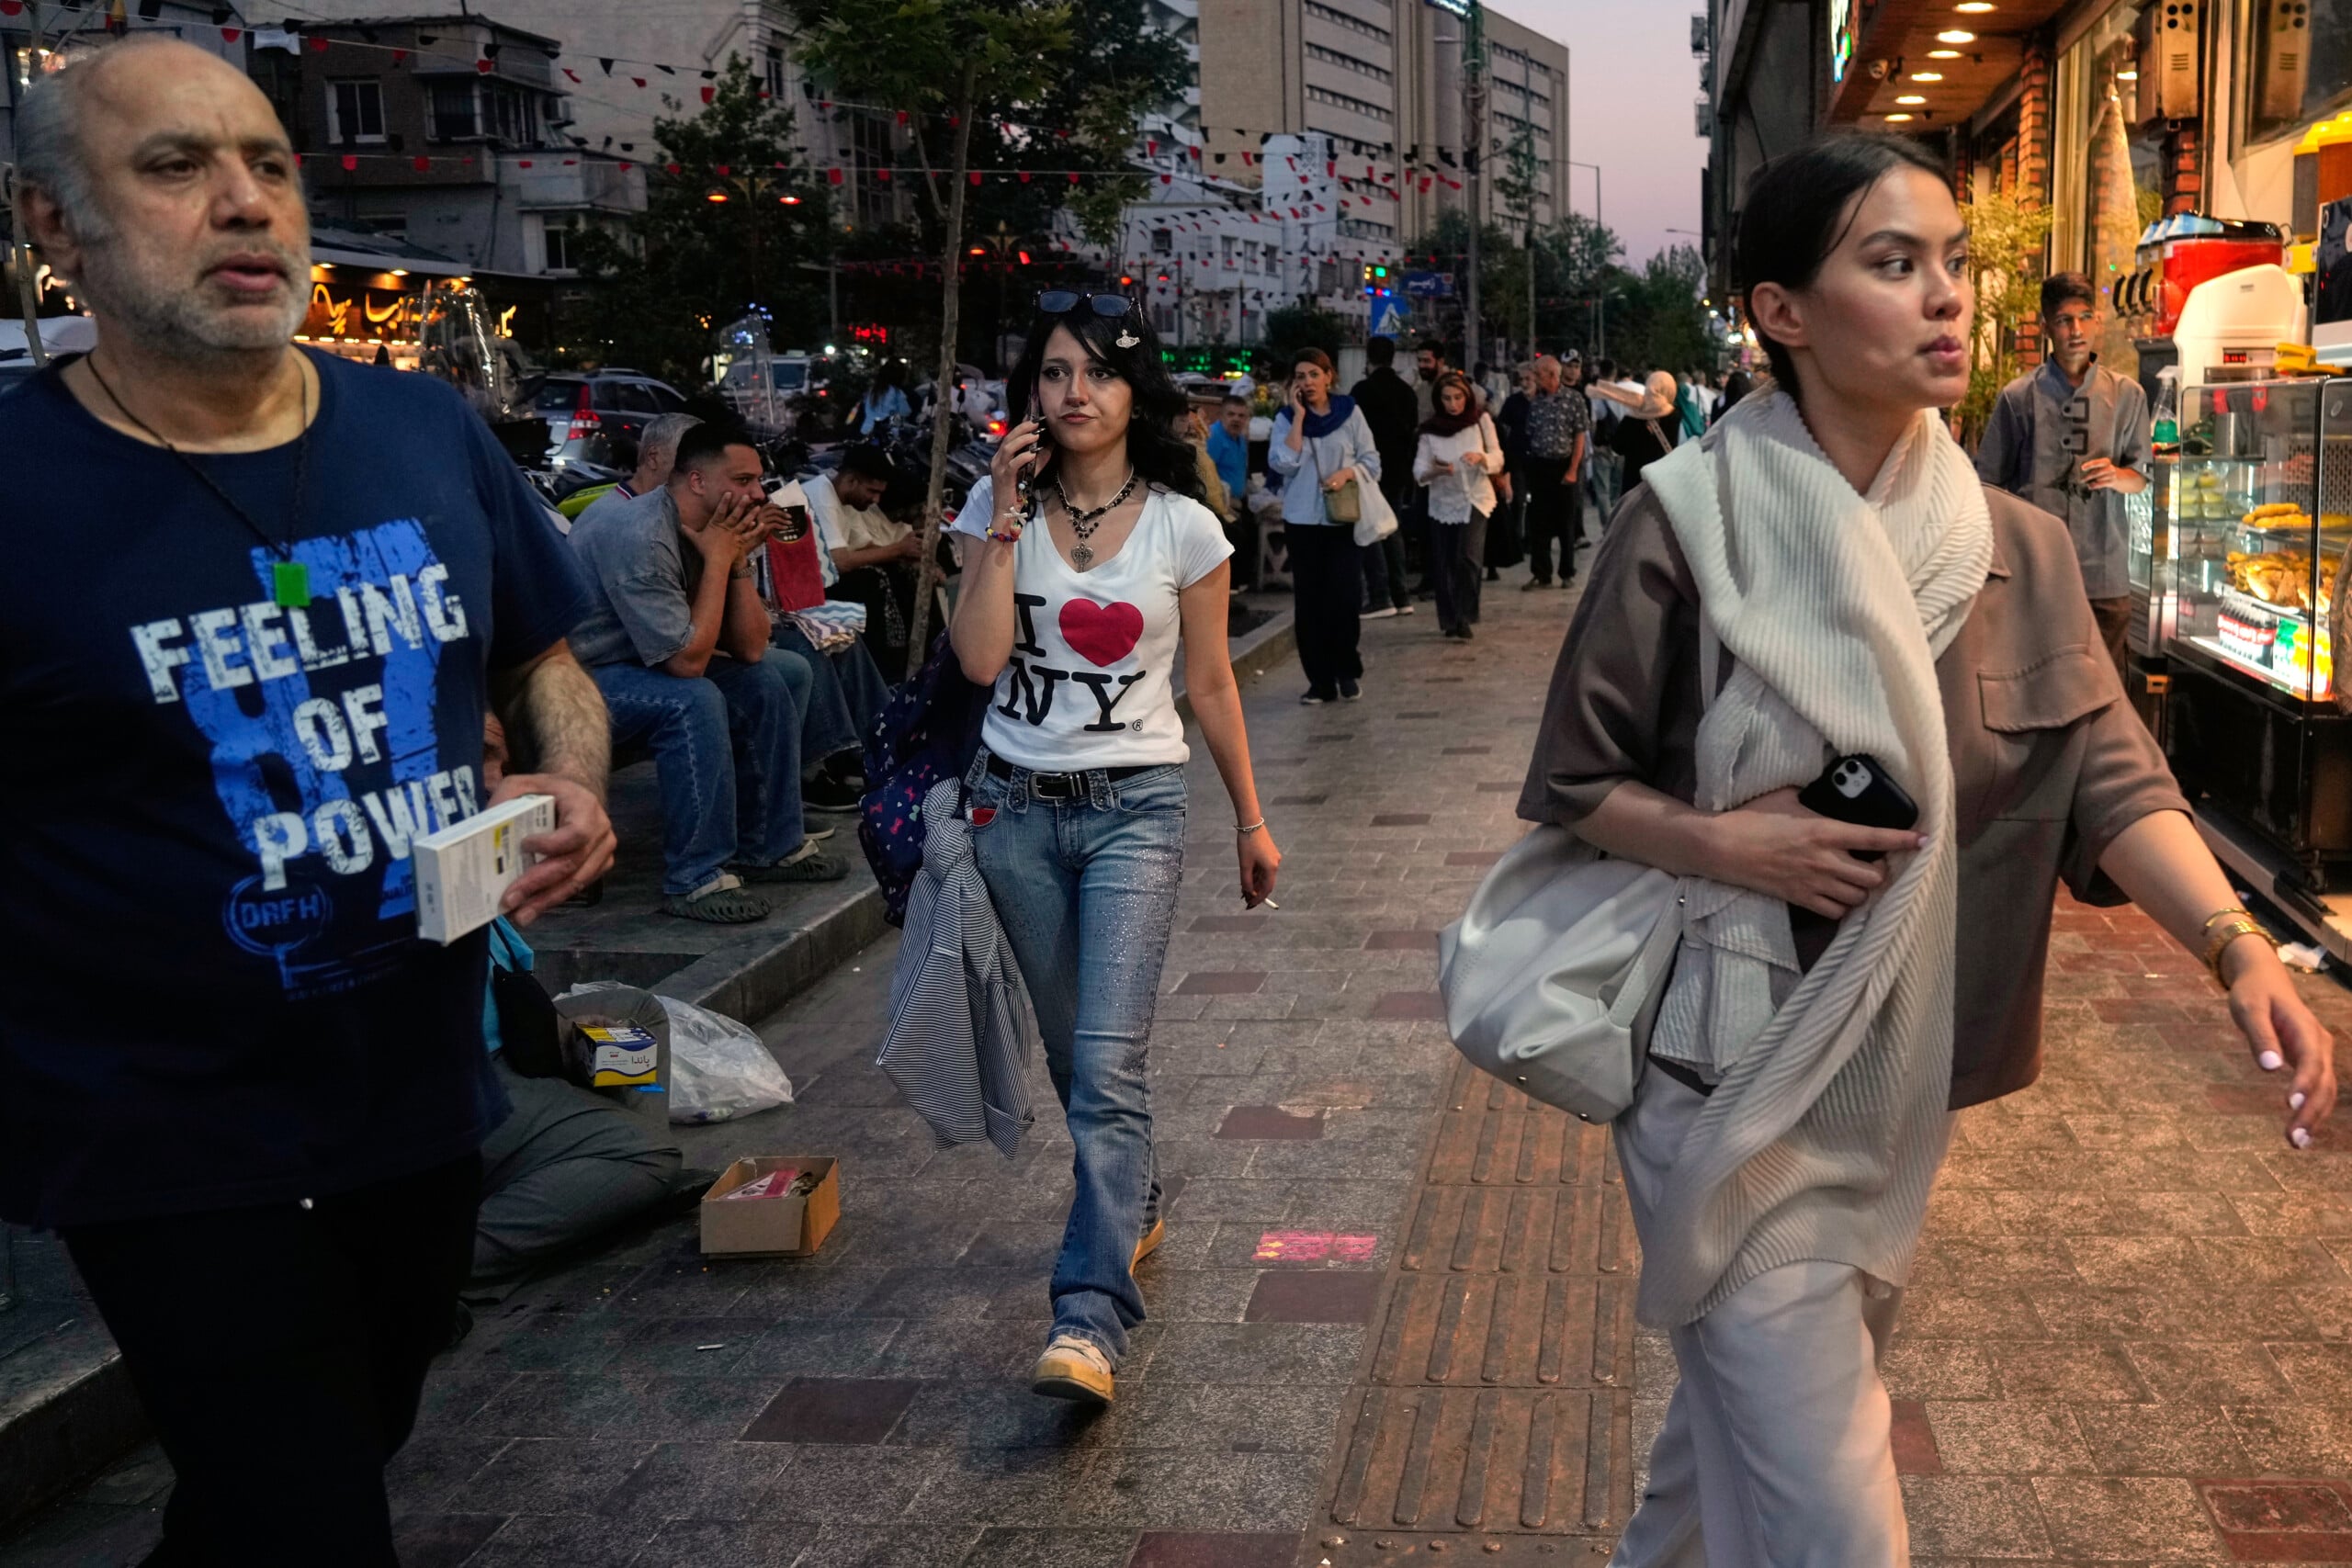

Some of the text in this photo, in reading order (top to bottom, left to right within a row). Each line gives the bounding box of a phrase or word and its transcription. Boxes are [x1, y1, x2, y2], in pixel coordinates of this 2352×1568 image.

[129, 562, 470, 705] FEELING
[1013, 592, 1046, 658] I
[293, 682, 390, 773] OF
[997, 655, 1147, 732] NY
[253, 764, 480, 892] POWER
[630, 1055, 650, 1068] پاندا
